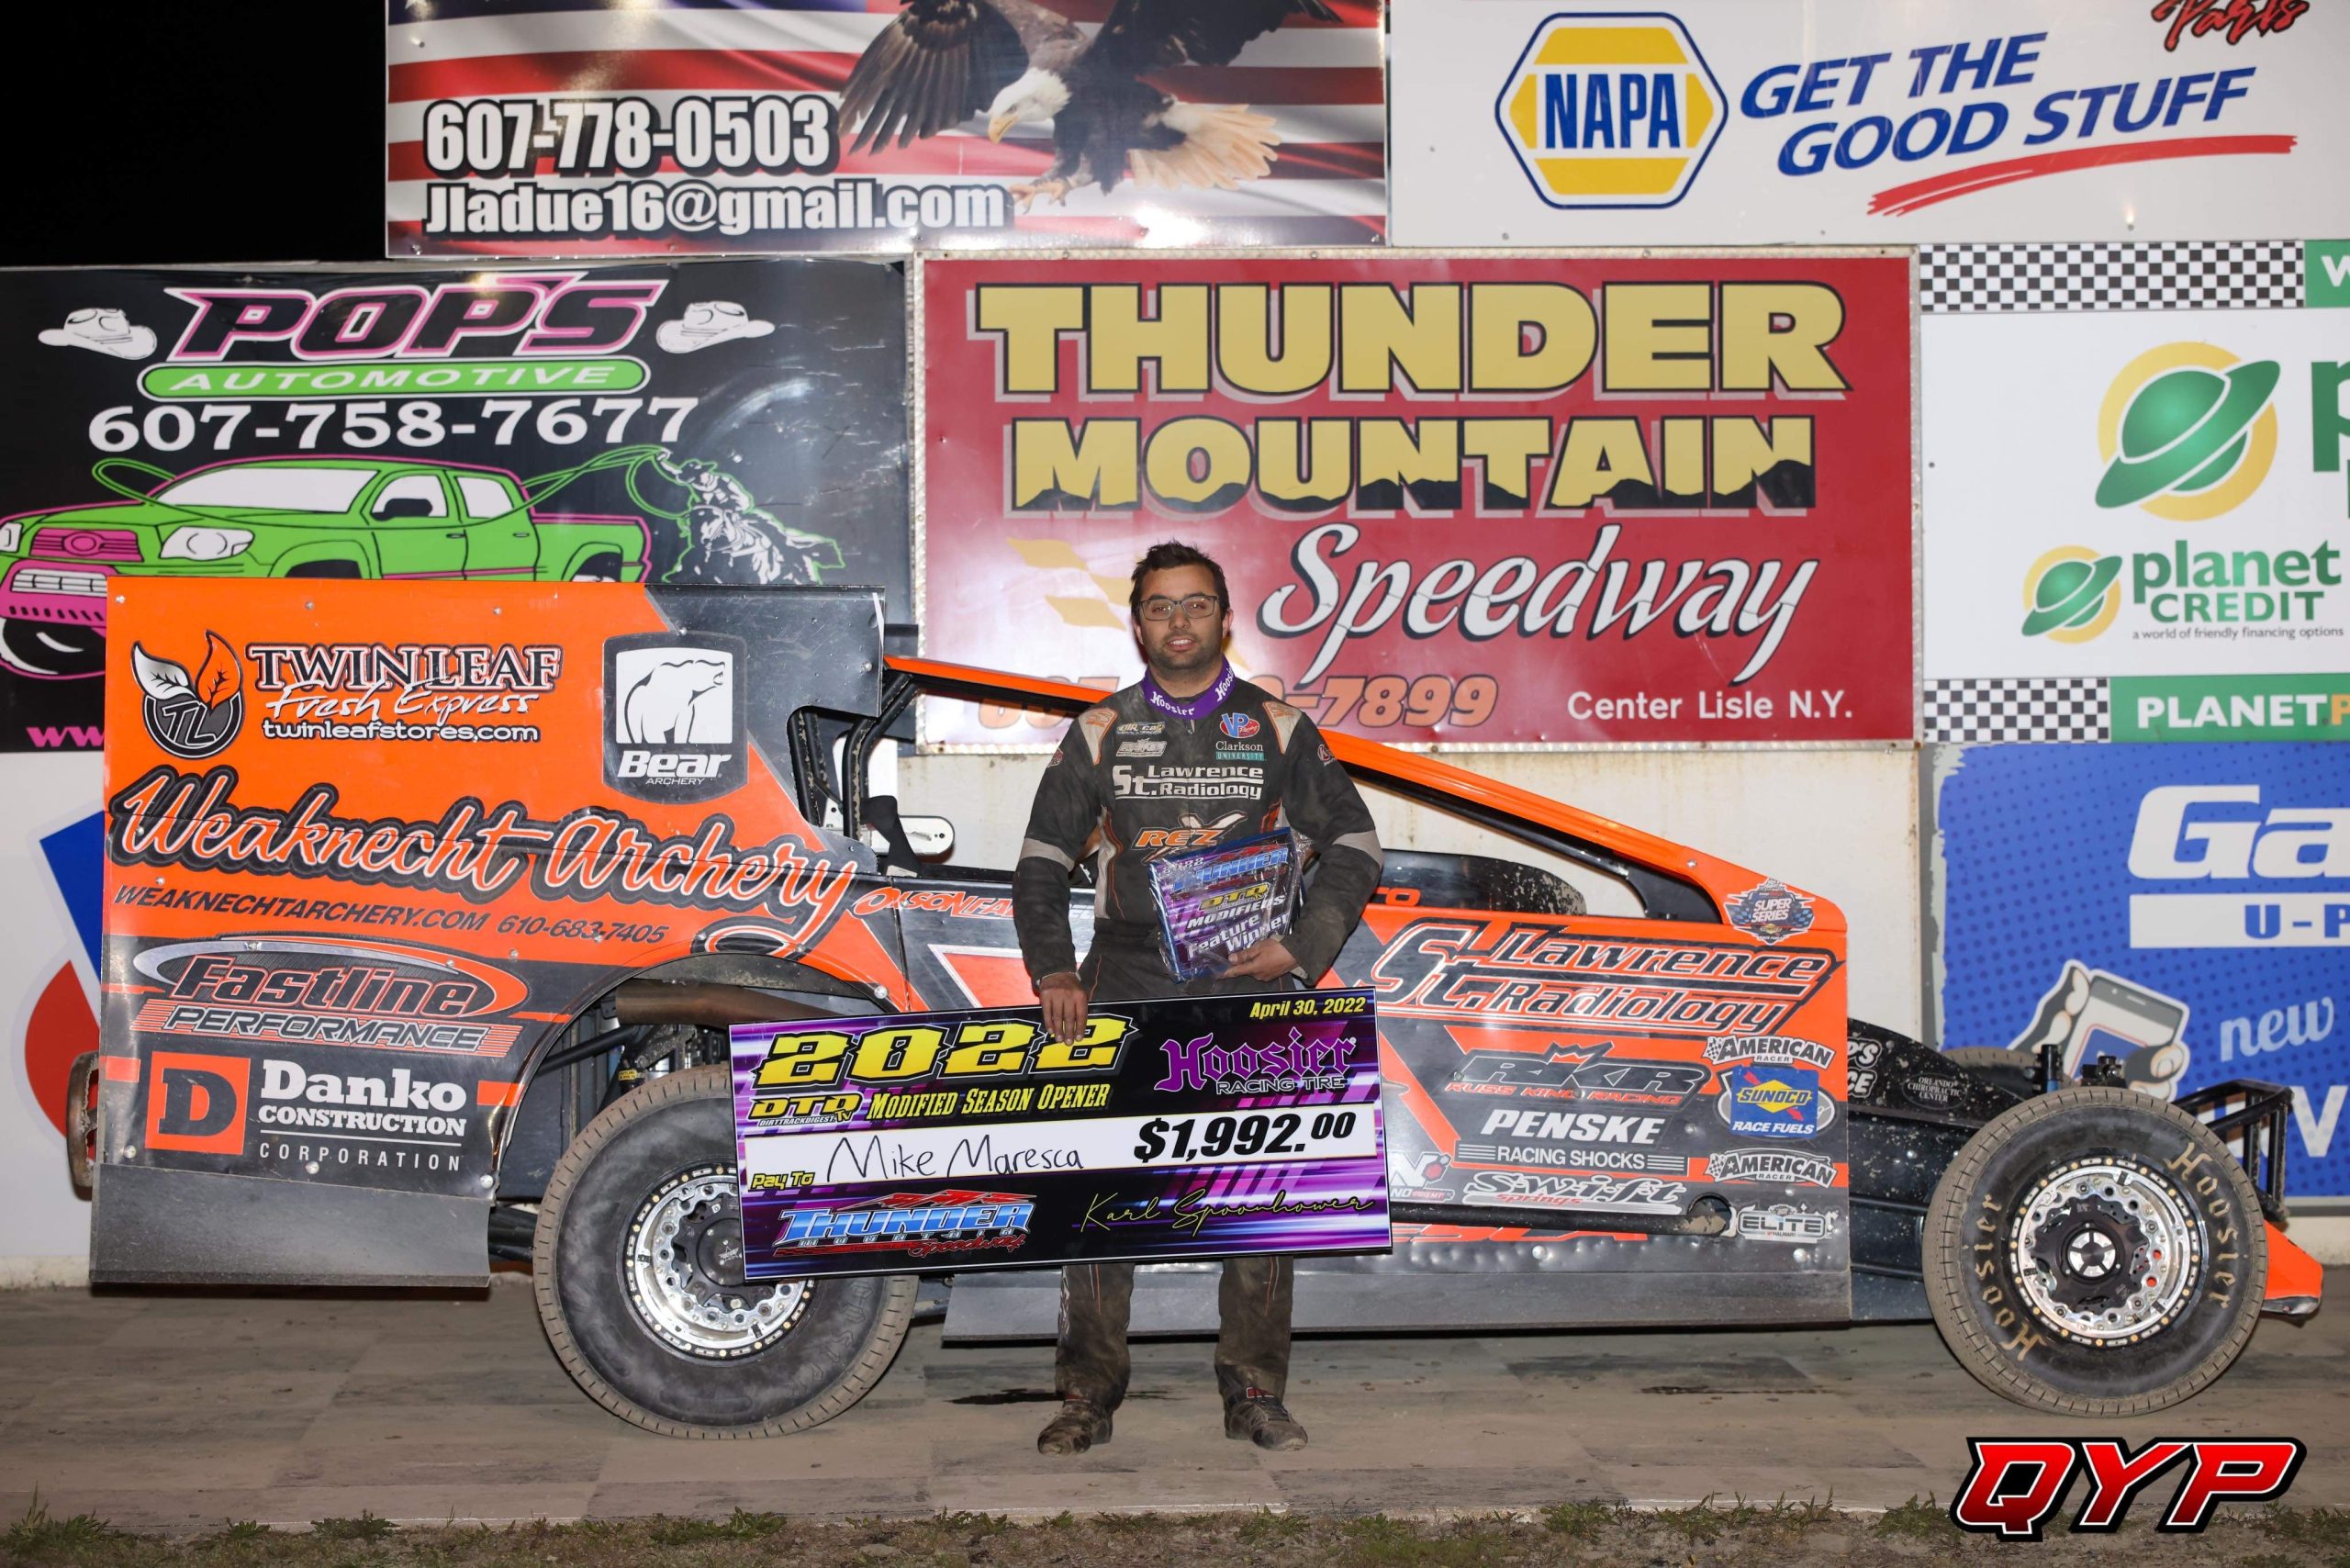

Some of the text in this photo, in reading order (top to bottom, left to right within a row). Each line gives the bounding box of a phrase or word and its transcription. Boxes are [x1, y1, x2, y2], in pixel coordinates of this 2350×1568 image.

[1740, 32, 2049, 118] GET THE
[1544, 73, 1680, 149] NAPA
[1777, 67, 2256, 176] GOOD STUFF
[425, 95, 832, 173] 607-778-0503
[968, 281, 1854, 401] THUNDER
[170, 366, 617, 391] AUTOMOTIVE
[88, 397, 699, 453] 607-758-7677
[1006, 415, 1817, 516] MOUNTAIN
[2132, 539, 2342, 604] planet
[1257, 522, 1818, 686] Speedway
[2150, 591, 2325, 622] CREDIT
[2132, 625, 2344, 641] a world of friendly financing options
[265, 675, 540, 725] Fresh Express
[1149, 690, 1195, 716] Hoosier
[1568, 689, 1852, 722] Center Lisle N.Y.
[1221, 712, 1249, 738] VP
[1215, 740, 1263, 751] Clarkson
[1217, 752, 1263, 761] UNIVERSITY
[617, 750, 732, 778] Bear
[1113, 765, 1264, 796] St. Lawrence
[1159, 783, 1262, 801] Radiology
[121, 773, 551, 893] Weaknecht
[1135, 829, 1225, 847] REZ
[112, 883, 669, 945] WEAKNECHTARCHERY.COM 610-683-7405
[1751, 908, 1789, 923] SERIES
[1752, 898, 1792, 912] SUPER
[1494, 925, 1833, 983] Lawrence
[170, 954, 481, 1018] Fastline
[1249, 997, 1366, 1019] April 30, 2022
[1492, 980, 1787, 1034] Radiology
[163, 1004, 488, 1052] PERFORMANCE
[2220, 996, 2334, 1062] new
[753, 1014, 1136, 1090] 2022
[1153, 1025, 1357, 1092] Hoosier
[1718, 1036, 1832, 1068] AMERICAN
[1756, 1055, 1791, 1063] RACER
[262, 1058, 466, 1113] Danko
[1216, 1076, 1346, 1094] RACING TIRE
[1444, 1082, 1517, 1095] RUSS
[1587, 1091, 1684, 1105] RACING
[1739, 1089, 1811, 1105] SUNOCO
[1907, 1081, 1962, 1097] CHIROPRACTIC
[1919, 1076, 1953, 1089] ORLANDO
[1919, 1092, 1949, 1103] CENTER
[158, 1068, 238, 1137] D
[749, 1092, 862, 1119] DTD
[867, 1082, 1112, 1121] MODIFIED SEASON OPENER
[258, 1105, 467, 1137] CONSTRUCTION
[1481, 1109, 1666, 1144] PENSKE
[1732, 1120, 1816, 1135] RACE FUELS
[1133, 1111, 1357, 1164] $1,992.00
[259, 1141, 460, 1171] CORPORATION
[826, 1133, 1085, 1183] Mike Maresca
[1497, 1146, 1646, 1170] RACING SHOCKS
[1720, 1153, 1834, 1187] AMERICAN
[751, 1170, 815, 1190] Pay To
[1080, 1191, 1161, 1233] Karl
[1171, 1188, 1374, 1237] Spoonhower
[1496, 1193, 1583, 1206] springs
[773, 1203, 1035, 1246] THUNDER
[1742, 1215, 1822, 1233] ELITE
[2165, 1141, 2238, 1310] Hoosier
[908, 1234, 1025, 1257] Speedway
[1973, 1193, 2047, 1362] Hoosier
